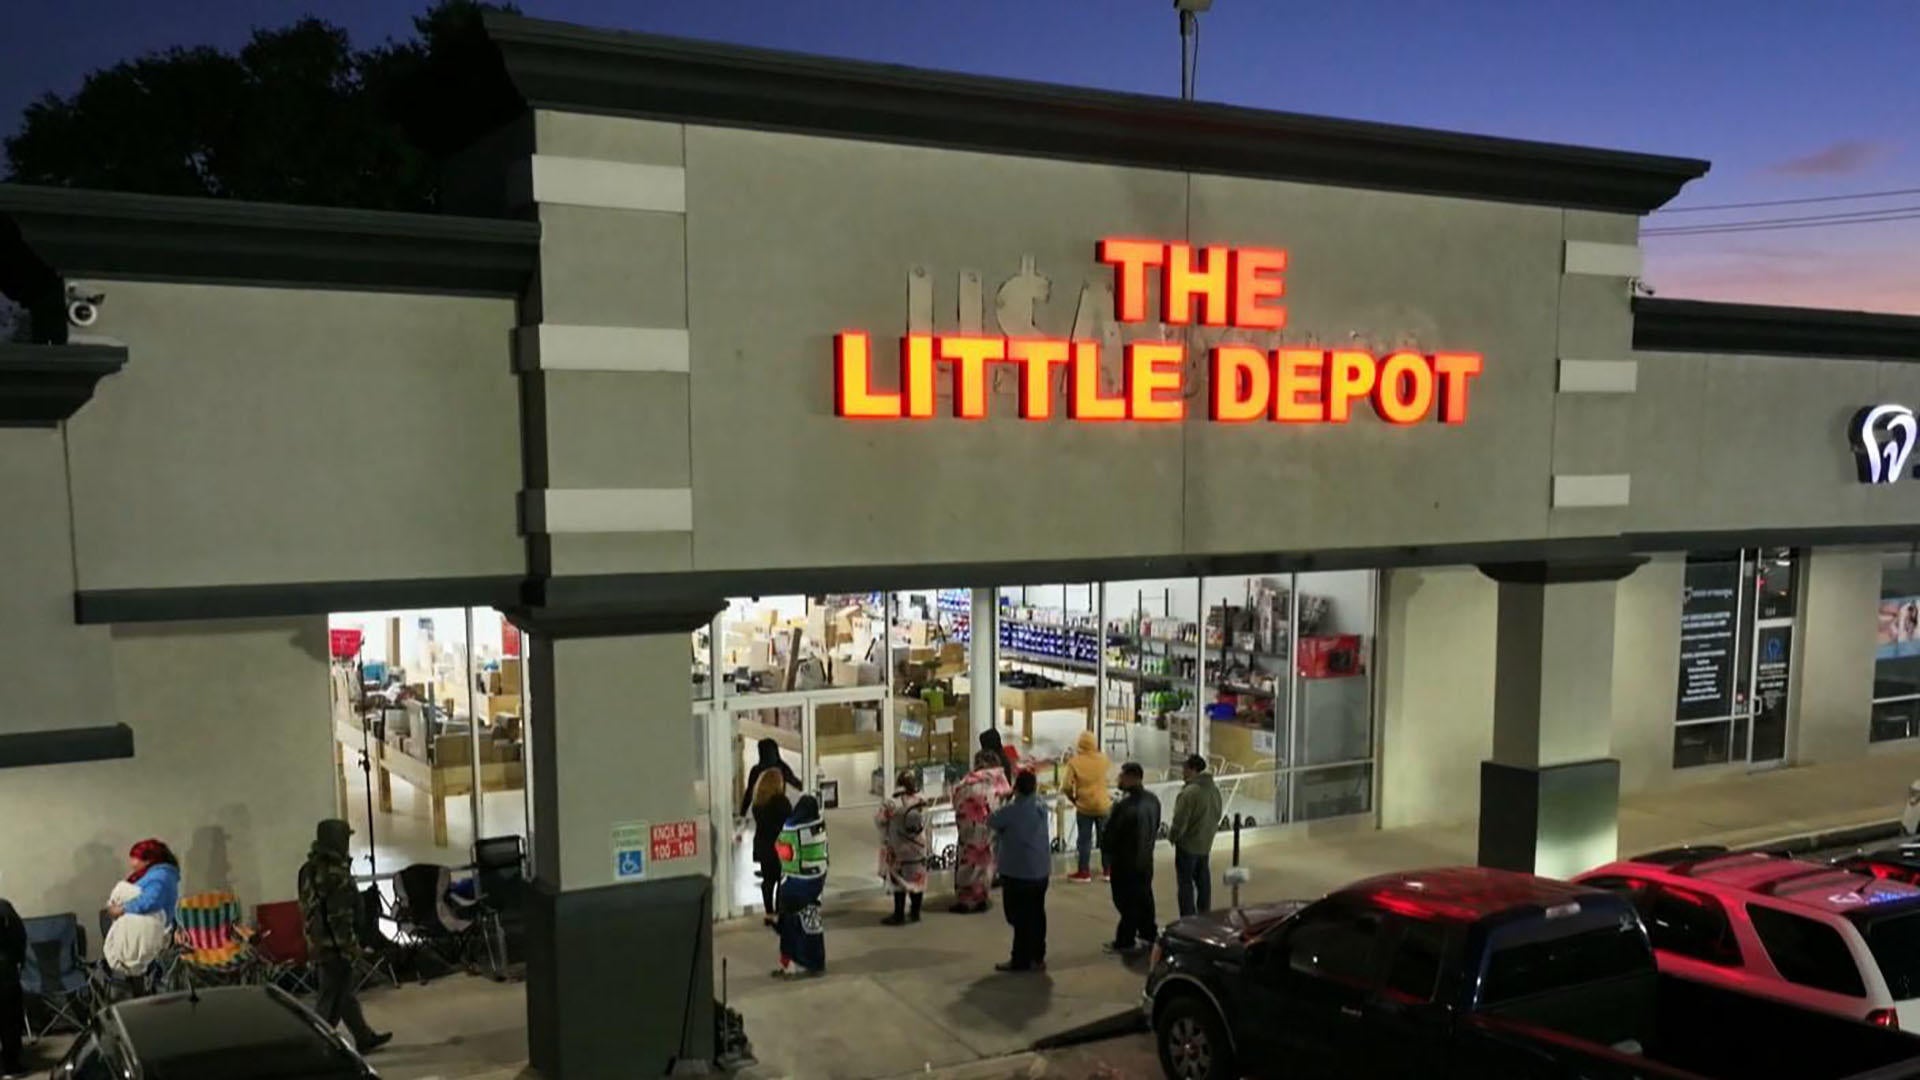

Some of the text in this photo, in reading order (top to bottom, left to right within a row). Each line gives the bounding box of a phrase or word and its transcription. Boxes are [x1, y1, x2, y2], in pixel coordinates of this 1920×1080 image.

[1097, 238, 1288, 331] THE
[834, 331, 1482, 425] LITTLE DEPOT
[653, 826, 676, 841] KNOX
[678, 822, 694, 838] BOX
